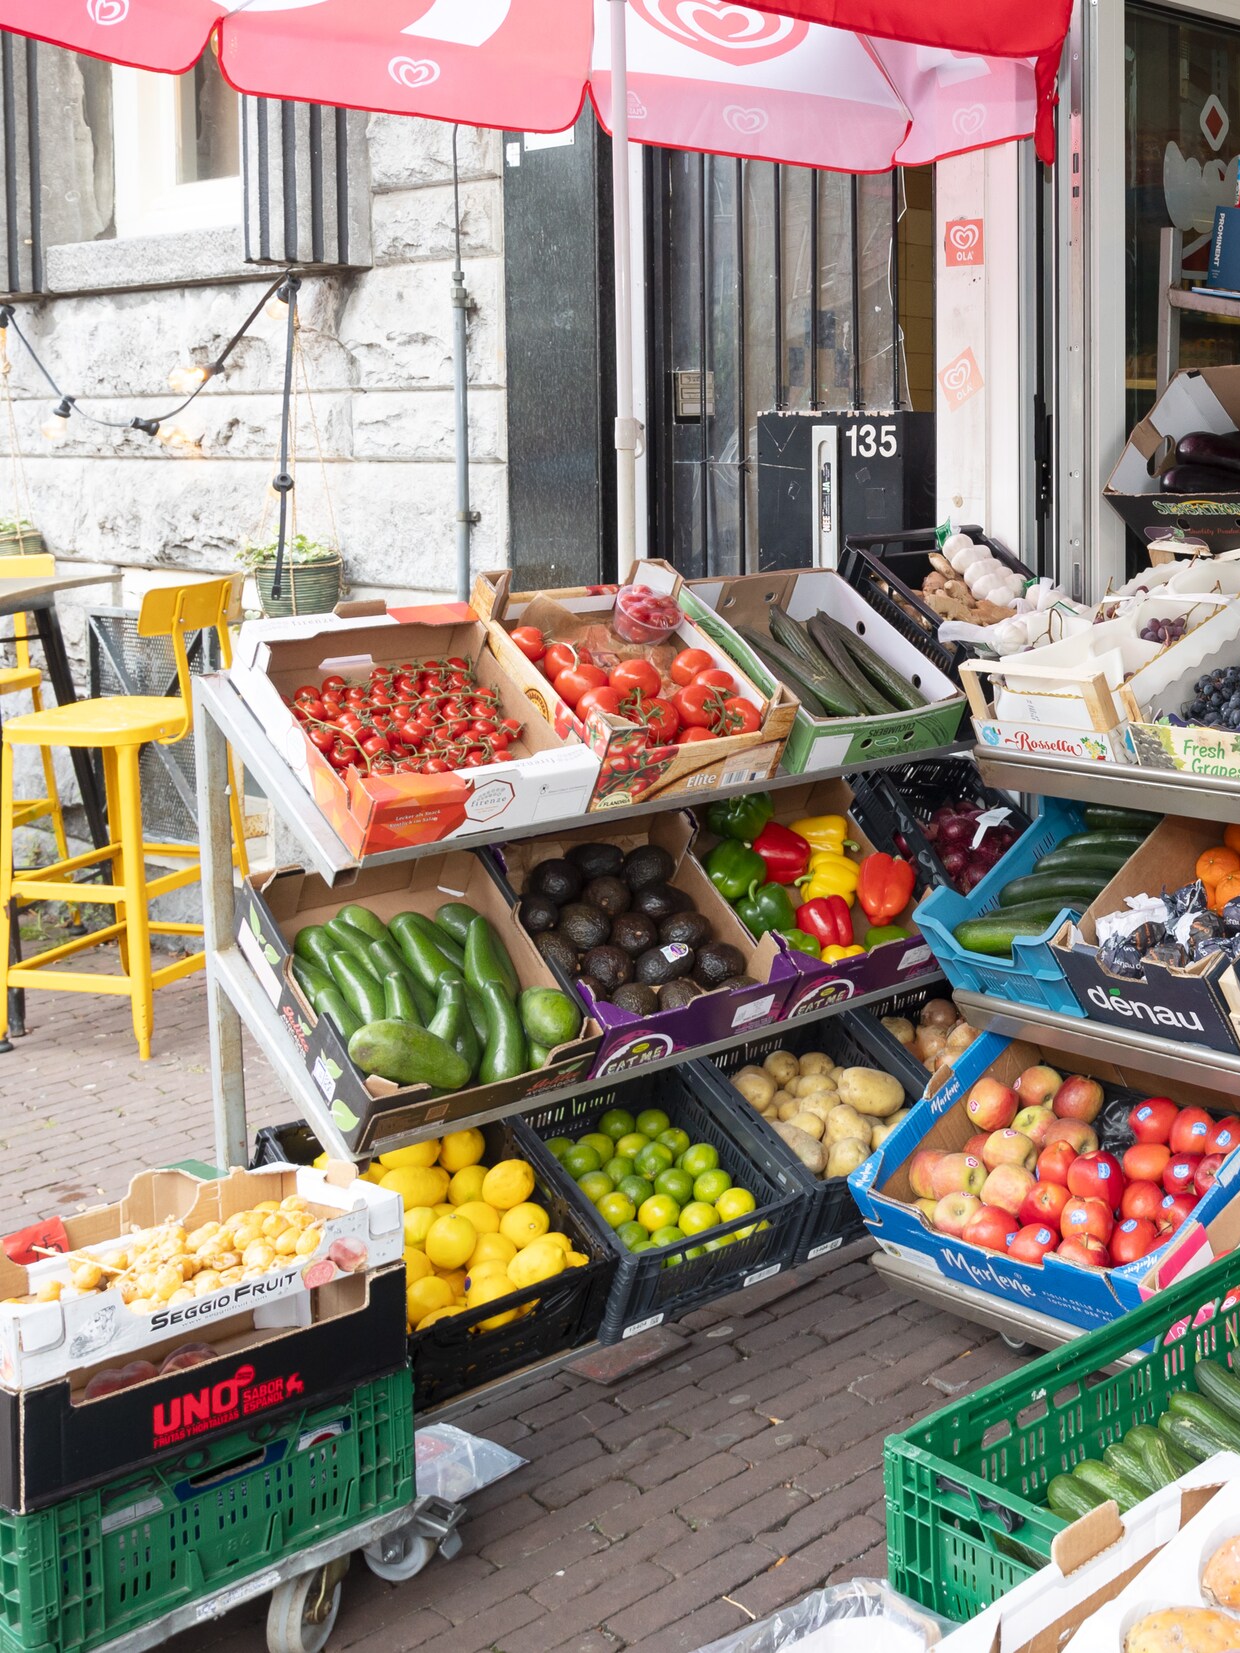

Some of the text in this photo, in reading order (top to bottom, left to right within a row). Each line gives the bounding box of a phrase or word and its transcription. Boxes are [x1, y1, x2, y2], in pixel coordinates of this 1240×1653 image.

[1213, 212, 1226, 267] PROMINENT
[845, 424, 898, 458] 135
[868, 722, 916, 738] CUCUMBERS
[1005, 730, 1082, 757] Rossella
[1183, 739, 1226, 760] Fresh
[686, 773, 717, 788] Elite
[471, 796, 508, 808] firenze
[602, 798, 631, 808] FLANDRIA
[797, 990, 846, 1016] EAT ME
[607, 1044, 664, 1075] EAT ME
[930, 1080, 960, 1115] Marlene
[940, 1248, 1037, 1298] Marlene
[150, 1271, 298, 1332] SEGGIO FRUIT
[243, 1378, 284, 1403] SABOR
[243, 1391, 285, 1416] ESPAÑOL
[153, 1379, 239, 1436] UNO
[153, 1409, 240, 1449] FRUTAS Y HORTALIZAS
